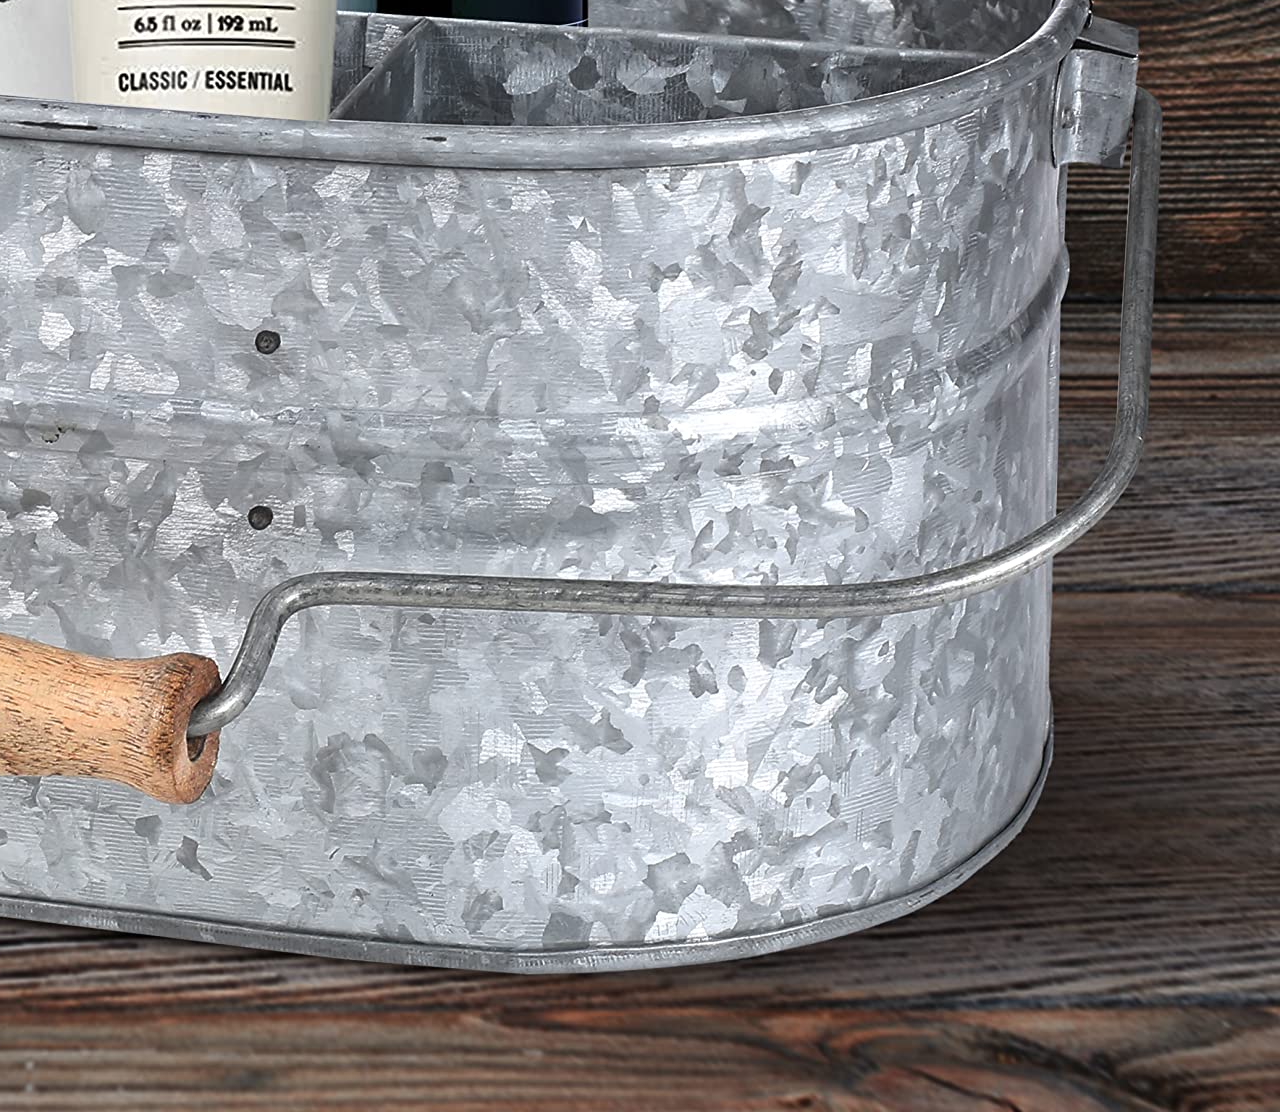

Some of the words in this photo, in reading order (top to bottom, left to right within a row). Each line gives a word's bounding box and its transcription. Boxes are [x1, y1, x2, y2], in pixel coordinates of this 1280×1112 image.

[181, 19, 202, 32] oz
[218, 15, 244, 32] 192
[248, 16, 278, 33] mL
[118, 70, 188, 92] CLASSIC
[204, 70, 293, 92] ESSENTIAL
